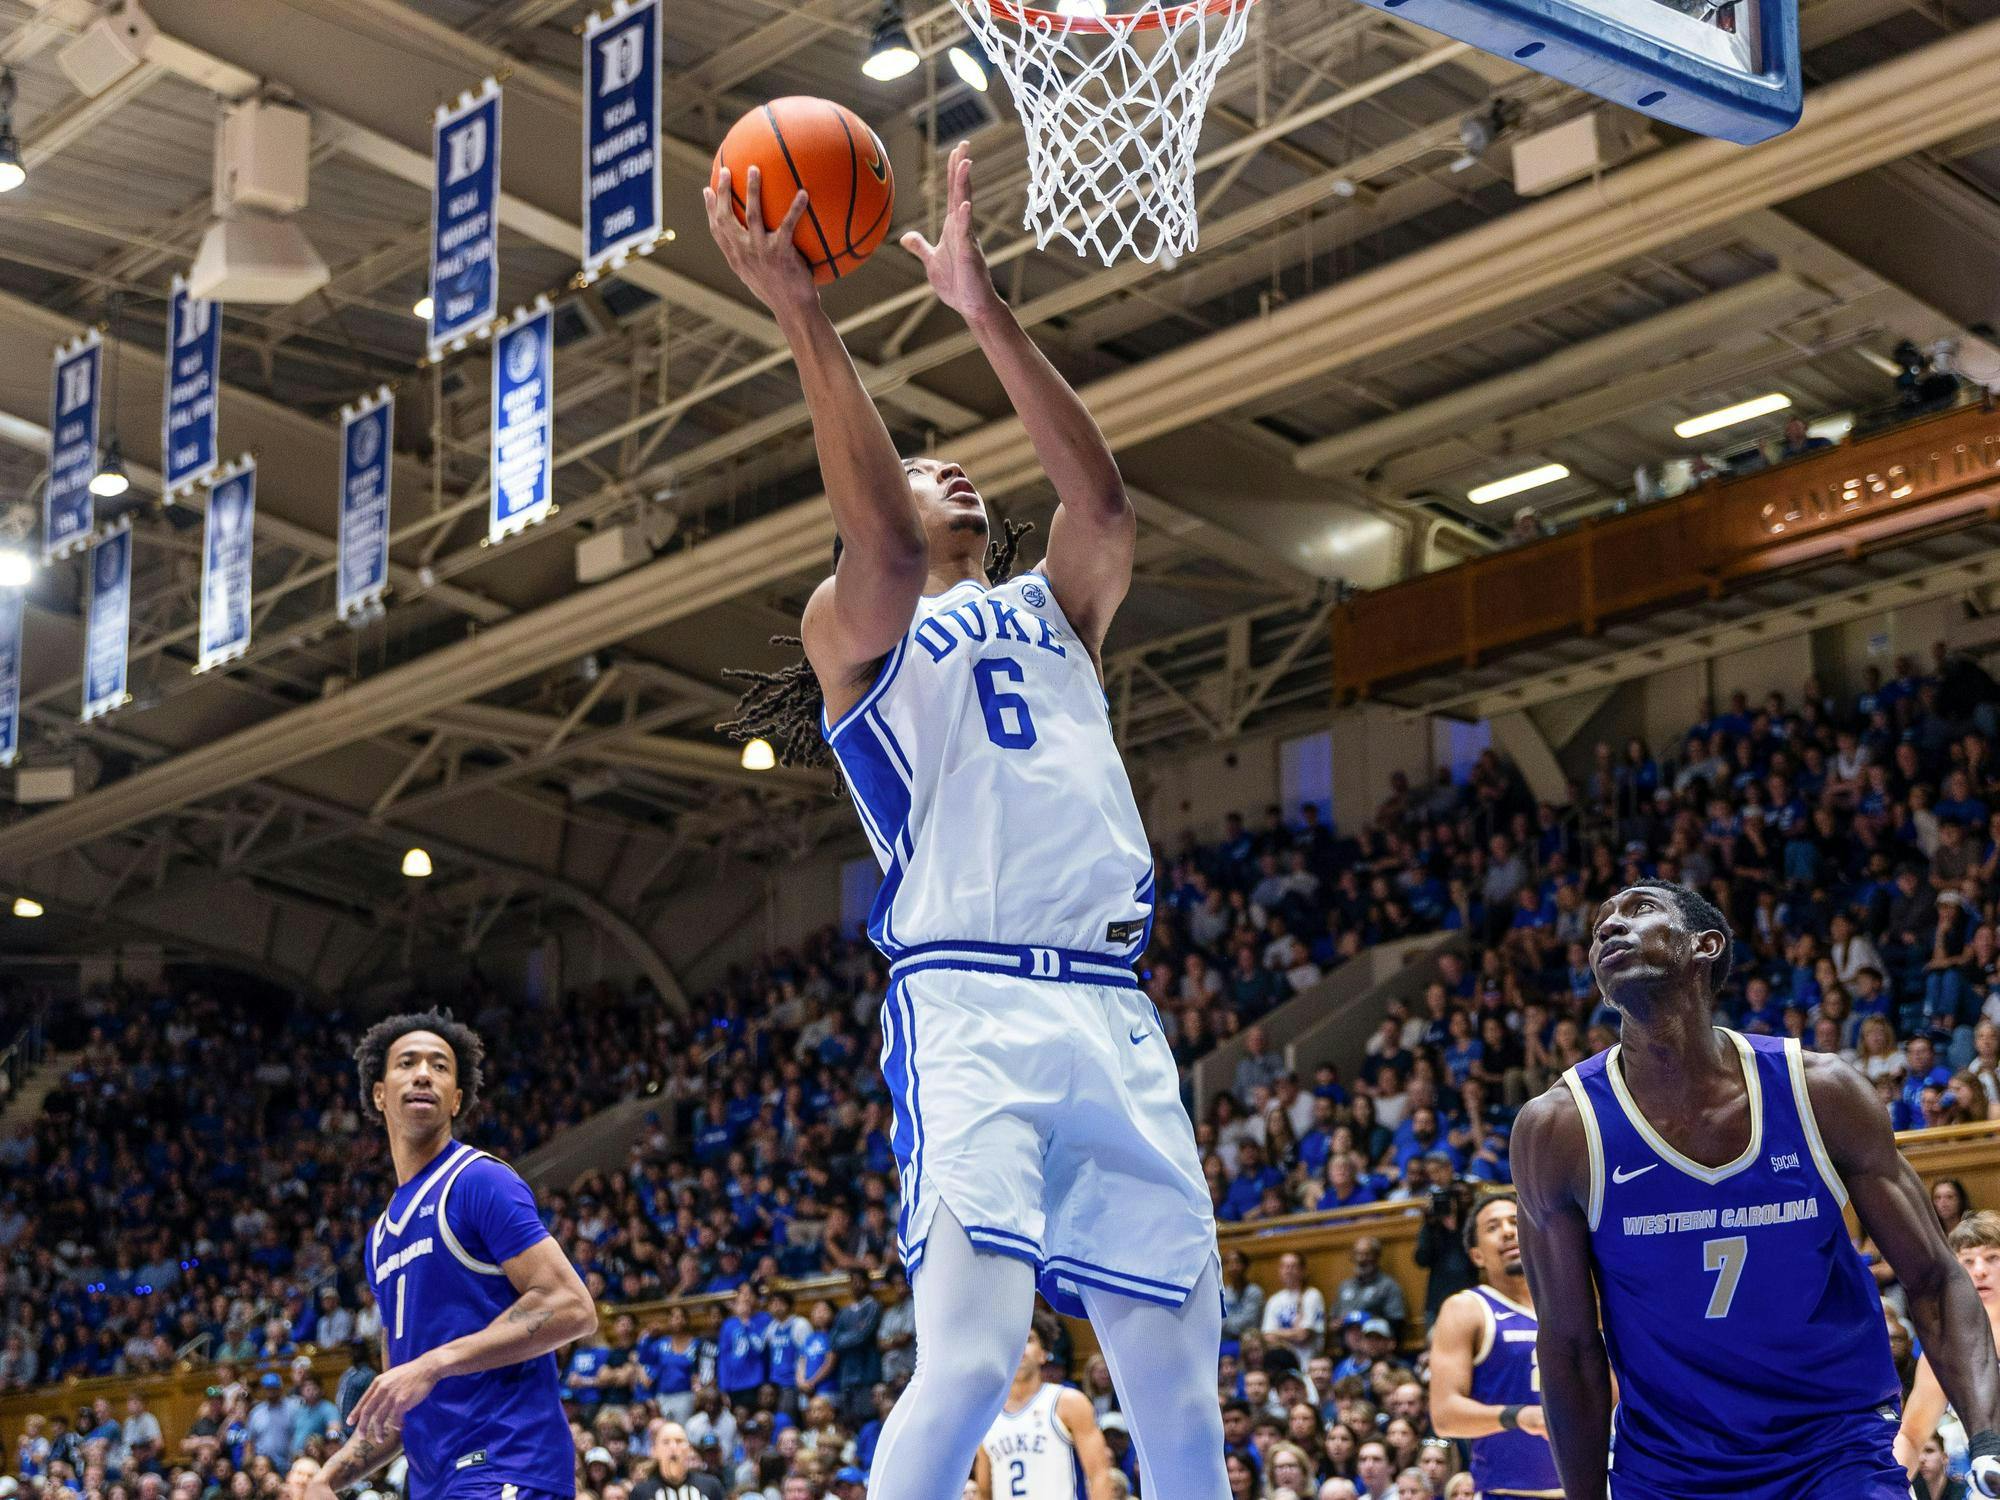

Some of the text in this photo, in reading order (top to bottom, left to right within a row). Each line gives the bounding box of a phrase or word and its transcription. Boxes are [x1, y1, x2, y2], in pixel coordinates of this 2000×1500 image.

[599, 23, 645, 97] D
[592, 121, 648, 166] WOMEN'S
[915, 599, 1066, 664] DUKE
[973, 657, 1037, 750] 6
[1029, 948, 1060, 978] D
[1623, 1197, 1819, 1236] WESTERN CAROLINA
[1703, 1235, 1748, 1319] 7
[395, 1273, 406, 1340] 1
[988, 1434, 1048, 1462] DUKE
[1010, 1460, 1027, 1497] 2
